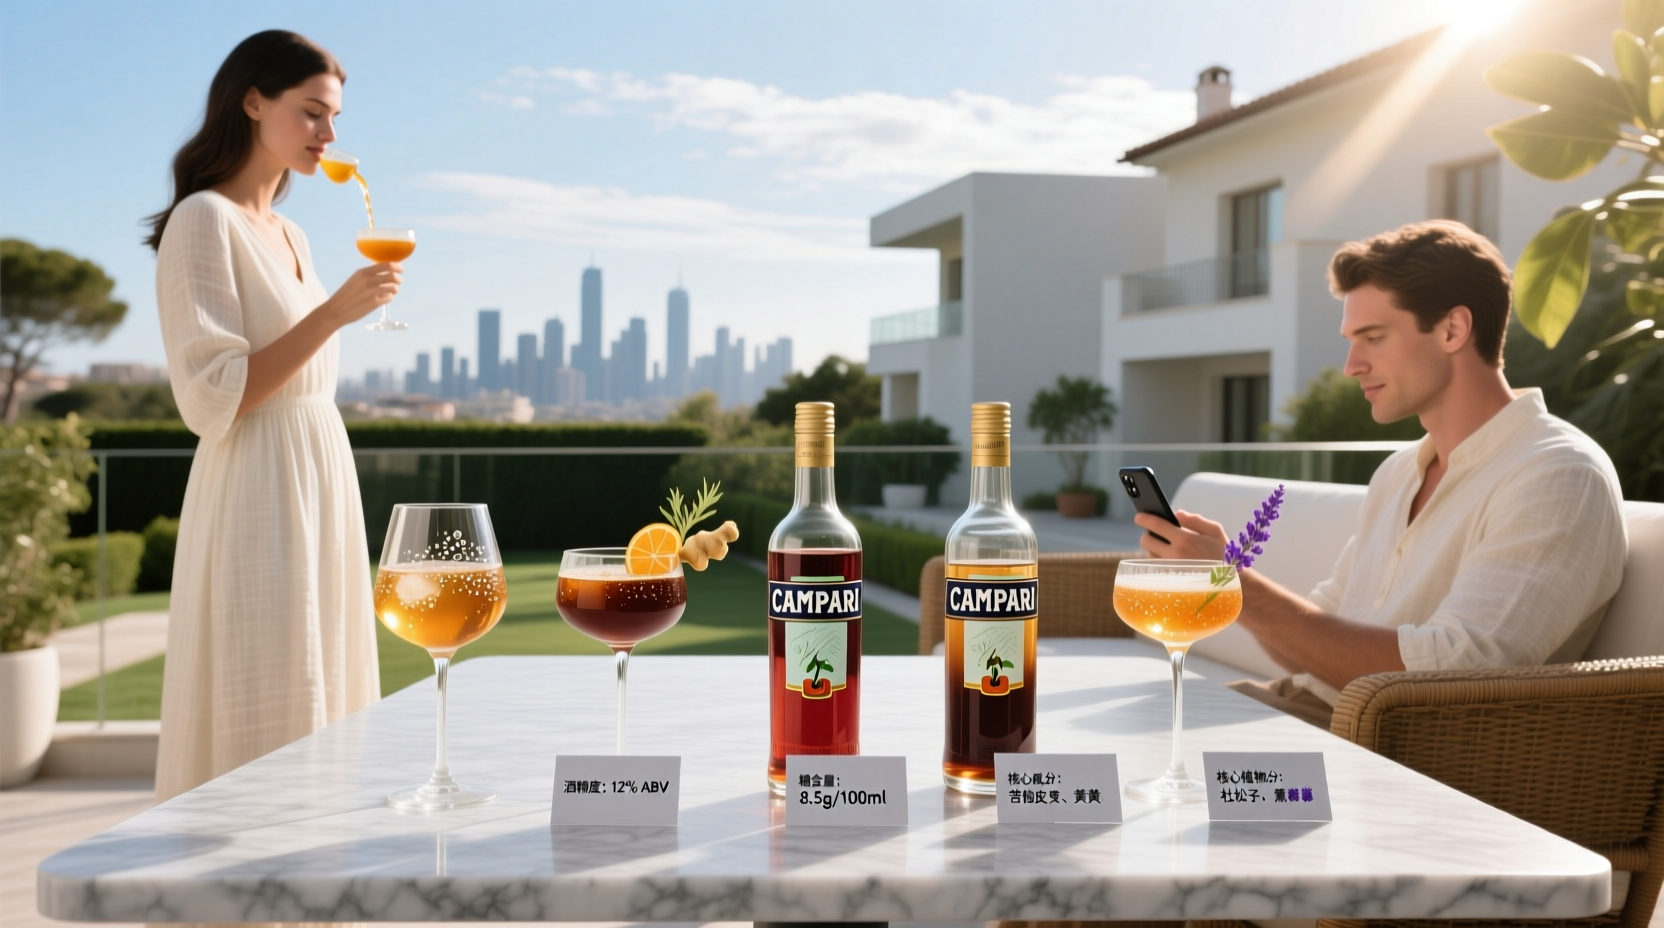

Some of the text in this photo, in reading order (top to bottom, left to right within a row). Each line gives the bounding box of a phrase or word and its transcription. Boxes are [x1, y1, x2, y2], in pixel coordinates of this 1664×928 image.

[772, 588, 859, 614] CAMPARI
[950, 586, 1035, 612] CAMPARI
[641, 780, 670, 794] ABV
[799, 789, 887, 810] 8.5g/100ml
